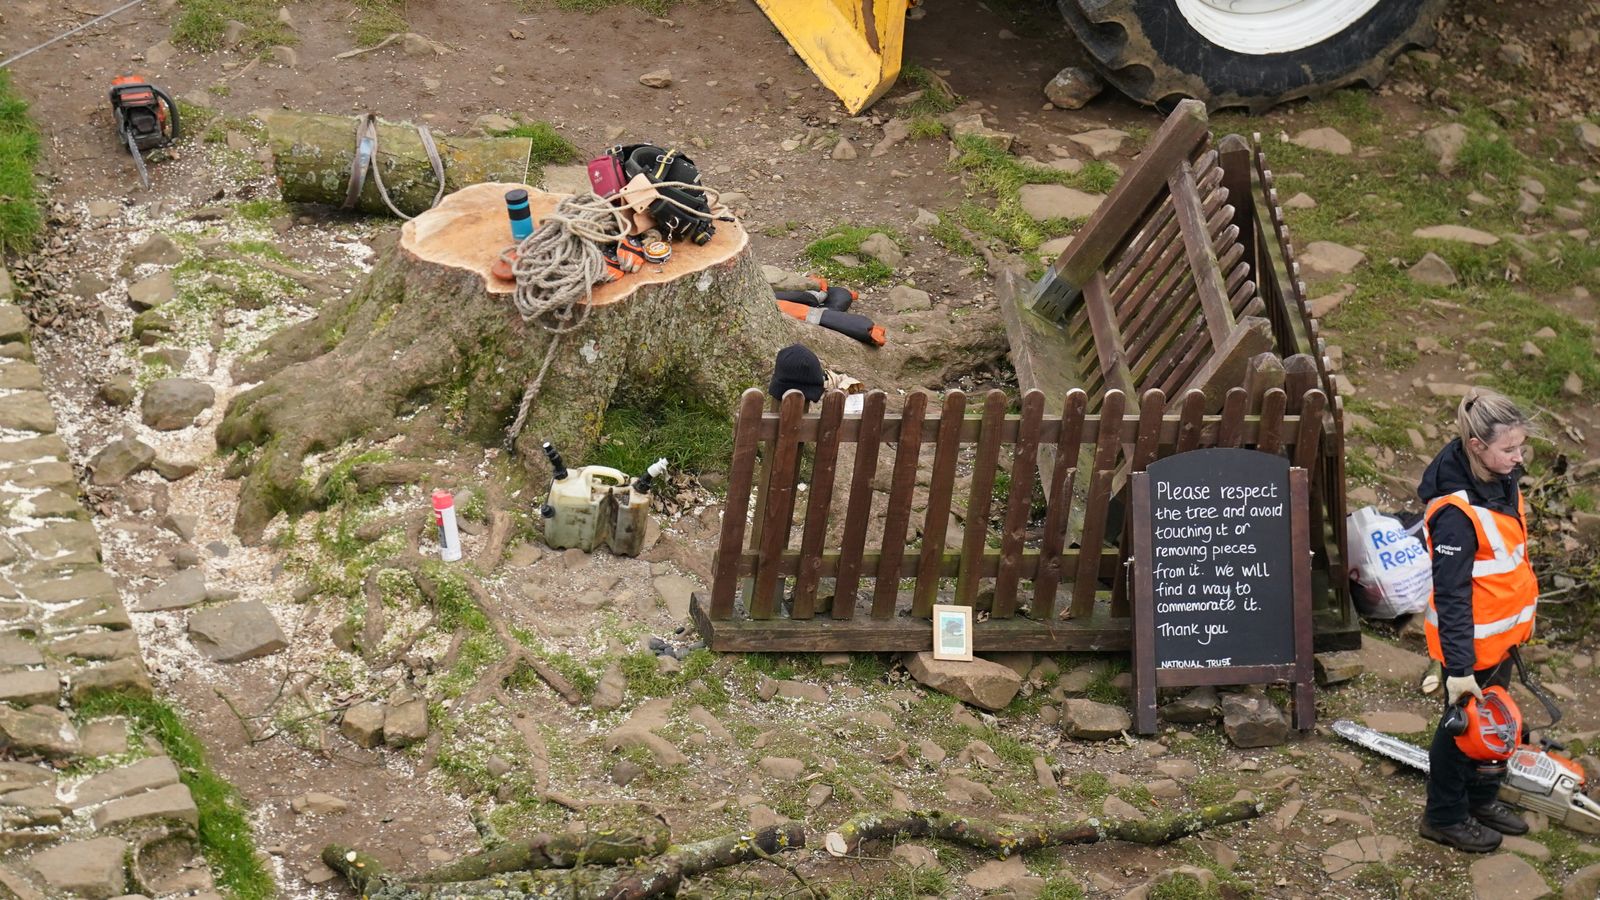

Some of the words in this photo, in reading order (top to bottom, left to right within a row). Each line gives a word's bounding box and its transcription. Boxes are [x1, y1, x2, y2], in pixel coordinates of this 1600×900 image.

[1157, 481, 1210, 500] Please
[1220, 483, 1278, 505] respect
[1155, 507, 1182, 521] the
[1185, 506, 1219, 519] tree
[1223, 505, 1245, 518] and
[1250, 503, 1283, 517] avoid
[1155, 524, 1212, 543] touching
[1216, 523, 1229, 536] it
[1235, 522, 1251, 534] or
[1156, 545, 1207, 562] removing
[1212, 543, 1257, 560] pieces
[1153, 563, 1185, 579] from
[1241, 562, 1270, 577] will
[1155, 582, 1182, 597] find
[1188, 584, 1196, 595] a
[1202, 584, 1231, 602] way
[1235, 581, 1251, 596] to
[1157, 599, 1236, 613] commemorate
[1244, 597, 1262, 611] it.
[1157, 622, 1200, 637] Thank
[1197, 624, 1228, 645] you
[1161, 659, 1204, 669] NATIONAL
[1205, 657, 1232, 668] TRUST
